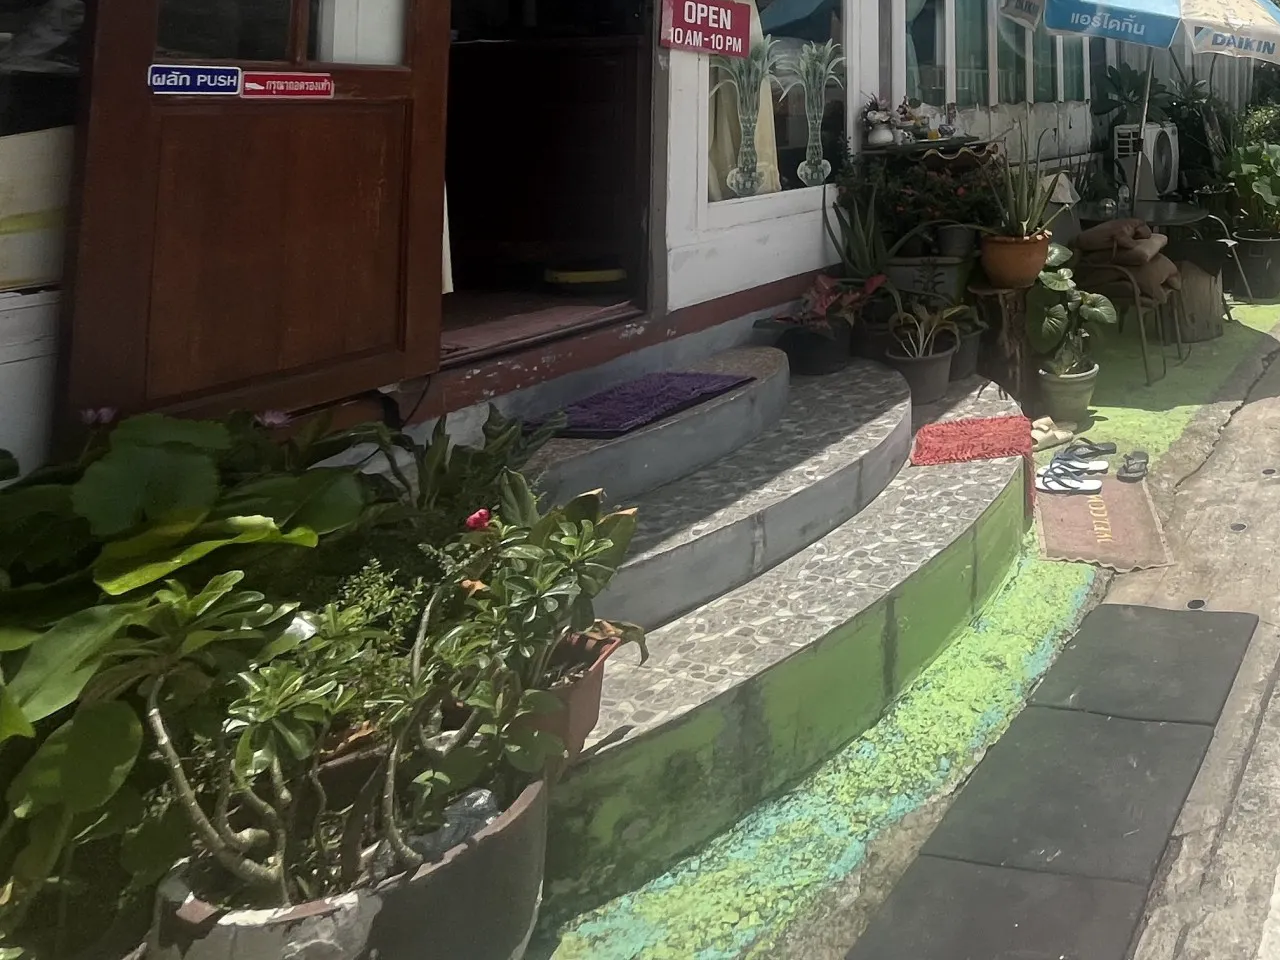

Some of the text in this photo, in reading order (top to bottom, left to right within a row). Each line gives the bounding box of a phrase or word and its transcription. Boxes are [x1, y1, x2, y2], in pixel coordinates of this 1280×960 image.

[684, 0, 732, 30] OPEN
[1211, 32, 1276, 55] DAIKIN
[152, 71, 237, 87] ผลัก PUSH
[1087, 494, 1113, 543] WELCOM
